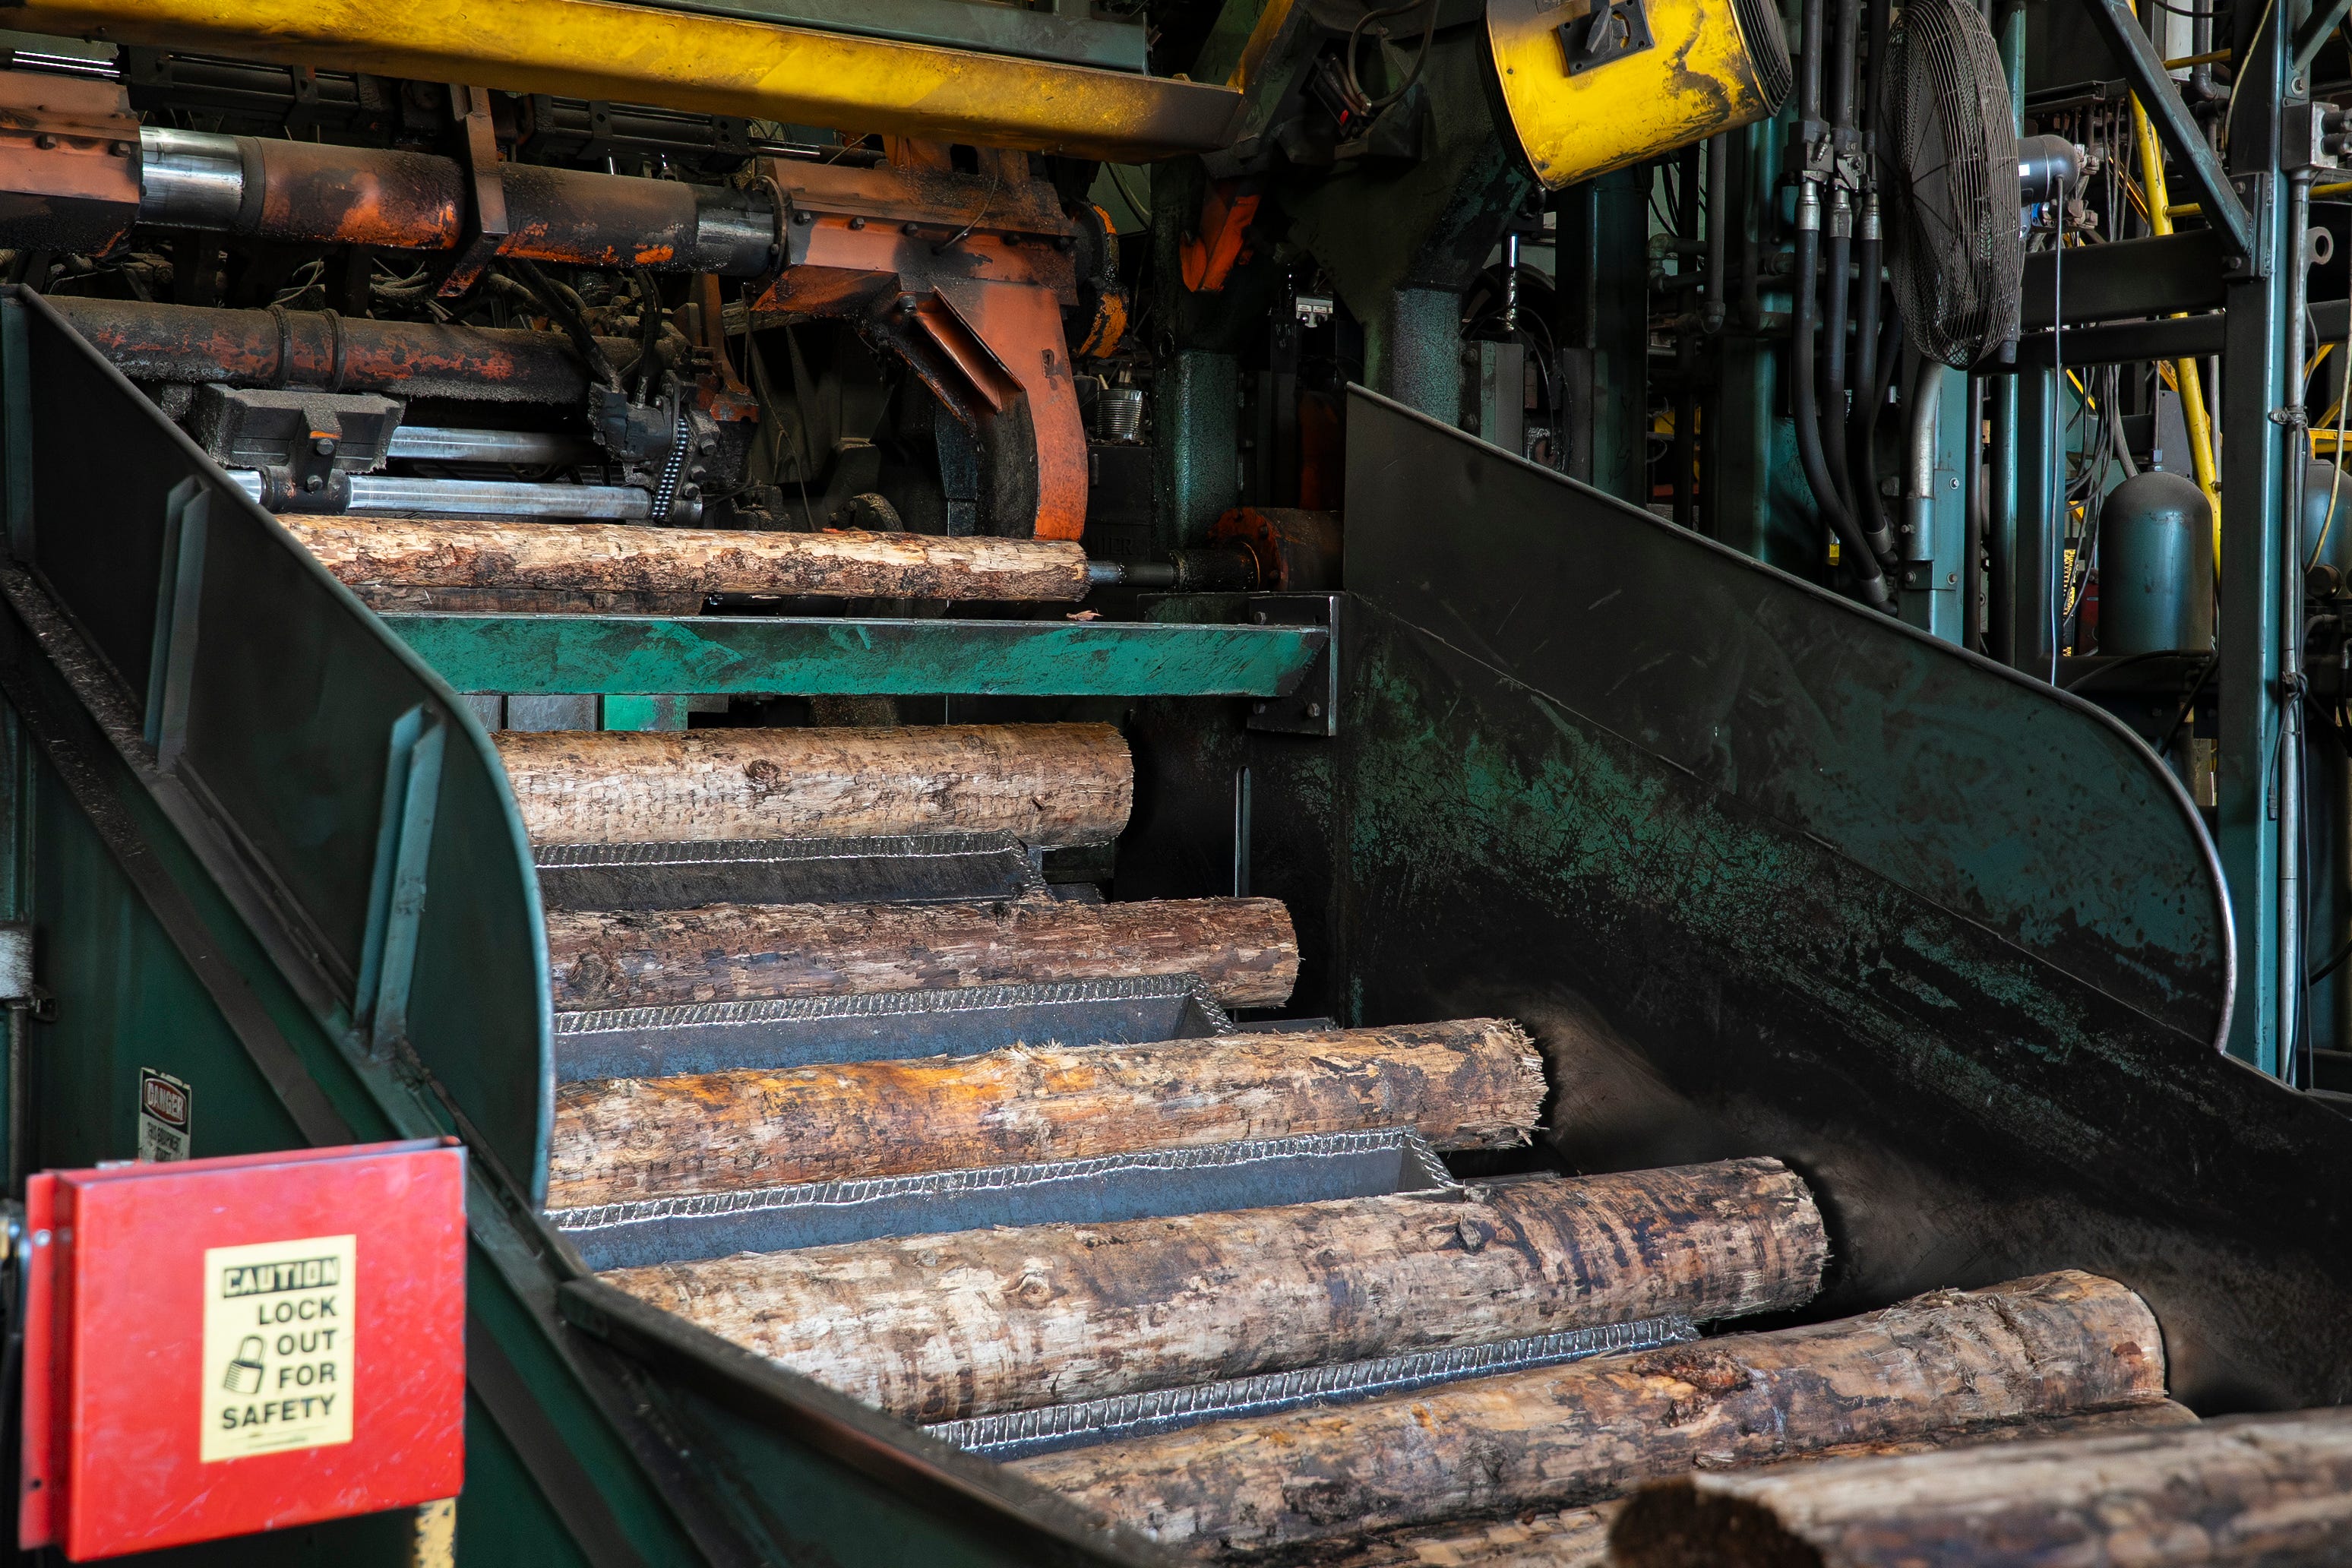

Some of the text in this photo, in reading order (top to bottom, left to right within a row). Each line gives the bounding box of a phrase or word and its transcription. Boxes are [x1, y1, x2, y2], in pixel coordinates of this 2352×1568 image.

[147, 1082, 184, 1121] DANGER
[225, 1258, 339, 1297] CAUTION
[259, 1296, 338, 1325] LOCK
[277, 1329, 340, 1355] OUT
[279, 1362, 336, 1389] FOR
[223, 1393, 337, 1429] SAFETY
